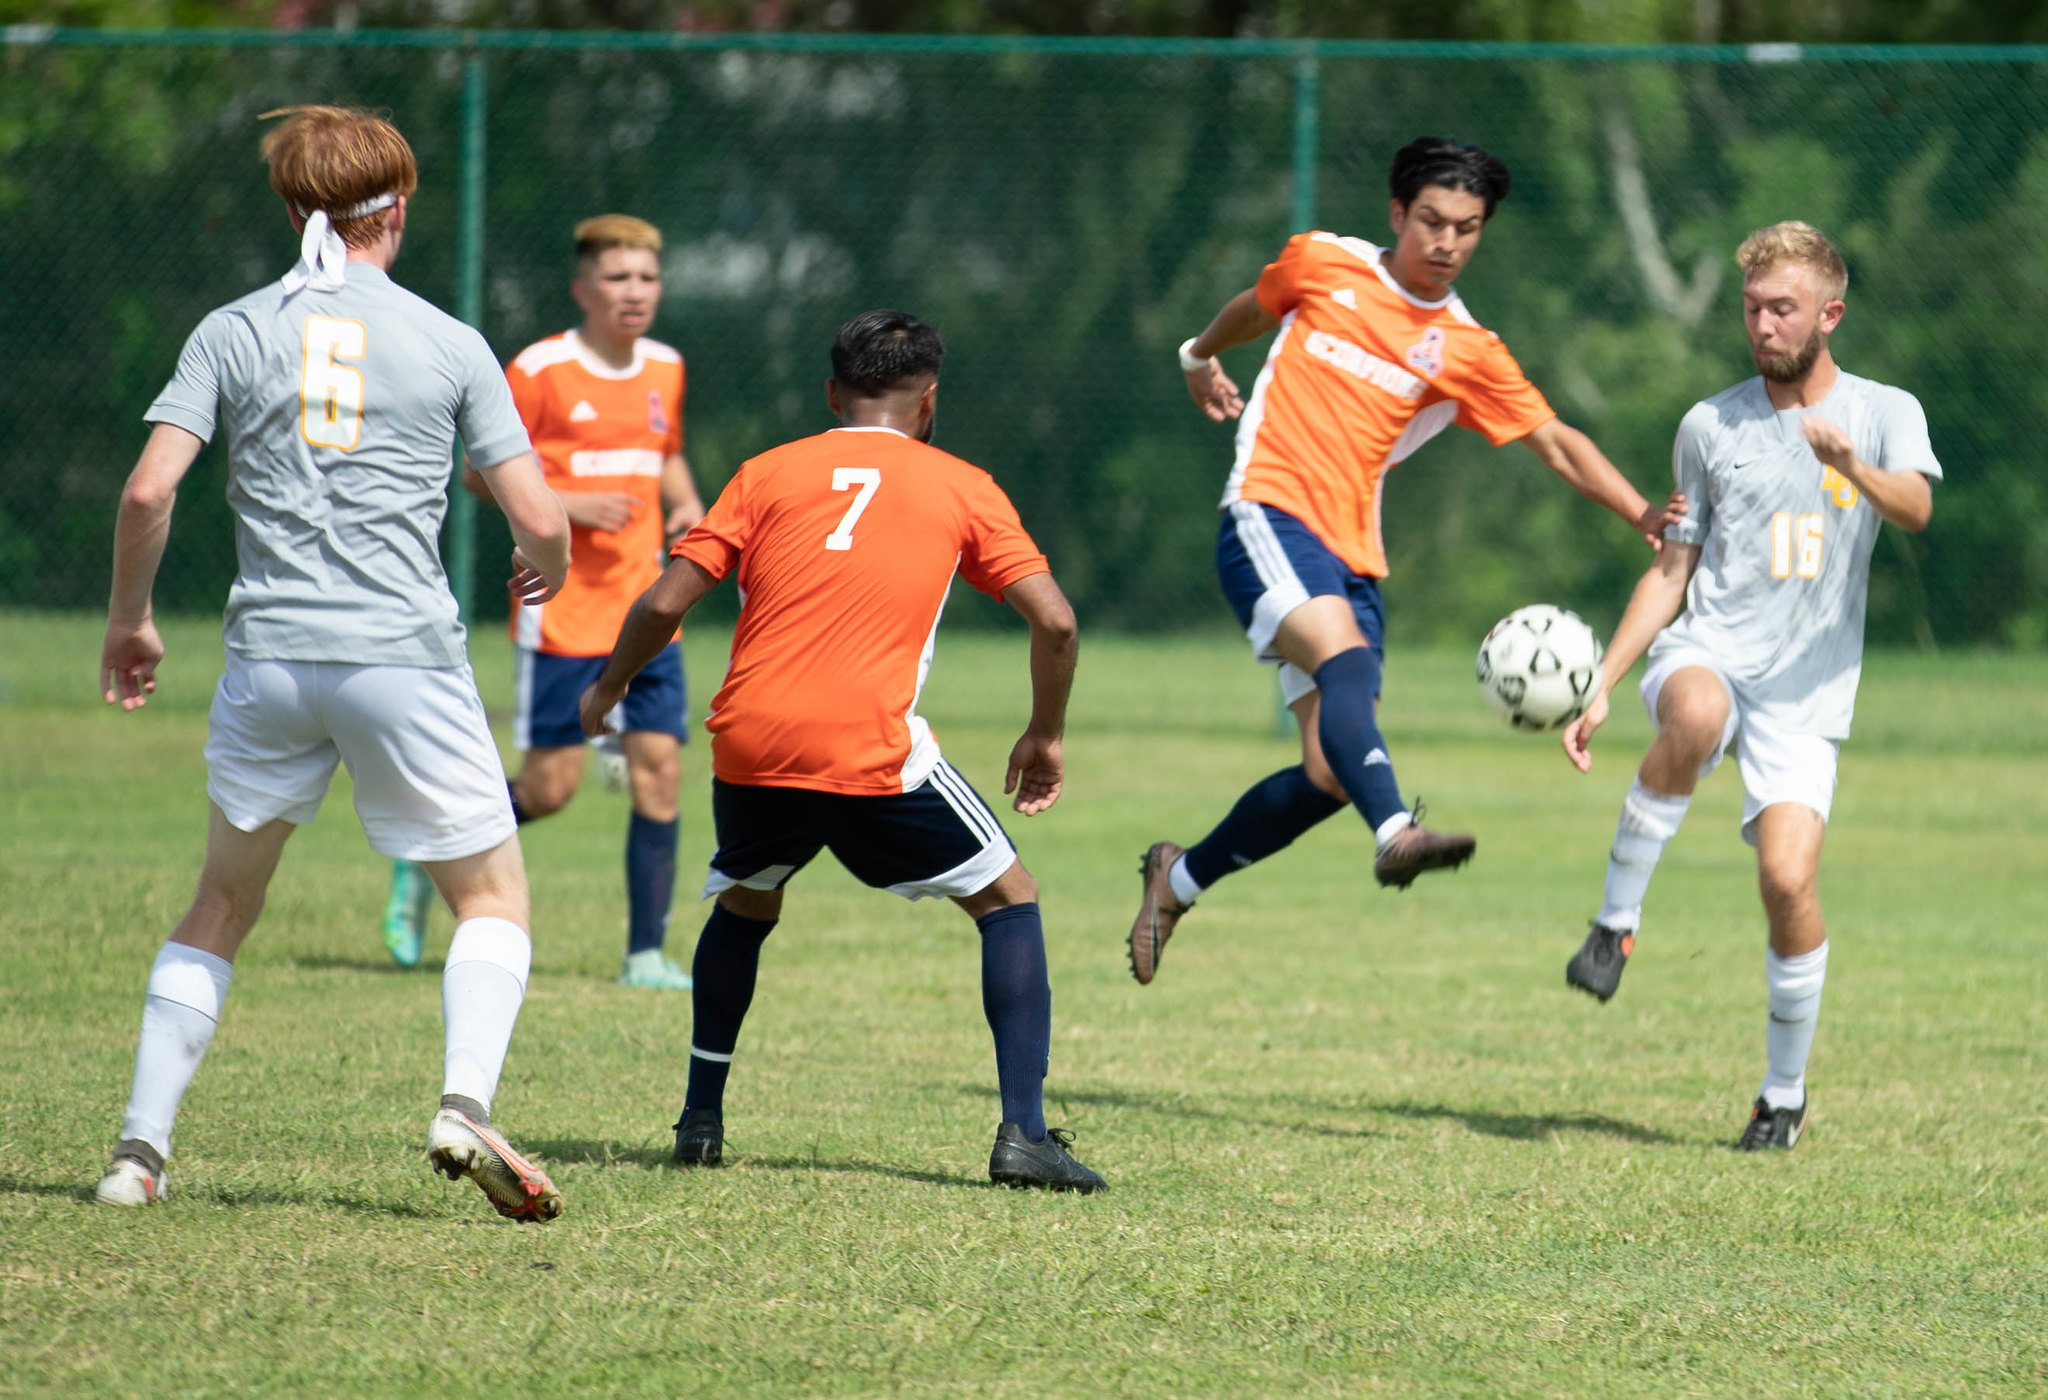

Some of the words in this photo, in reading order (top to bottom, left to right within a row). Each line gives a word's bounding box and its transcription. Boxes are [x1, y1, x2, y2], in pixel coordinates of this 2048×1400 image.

[300, 313, 367, 453] 6
[825, 467, 881, 551] 7
[1770, 511, 1824, 579] 16
